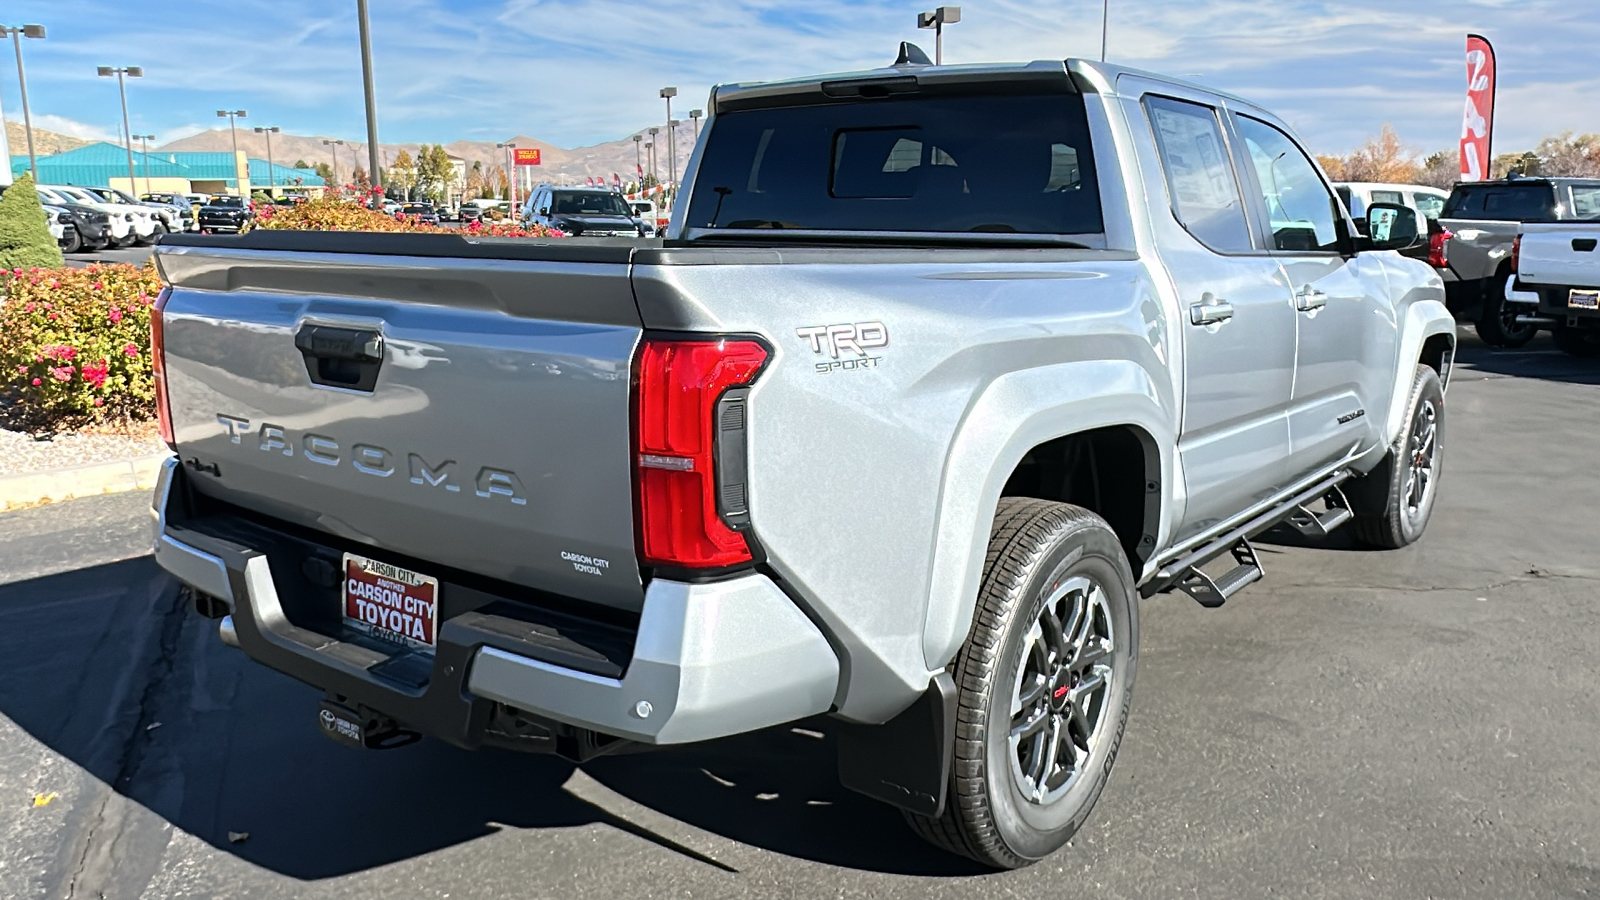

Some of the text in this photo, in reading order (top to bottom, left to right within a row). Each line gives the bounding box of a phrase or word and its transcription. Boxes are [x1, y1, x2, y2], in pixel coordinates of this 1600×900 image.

[795, 321, 889, 359] TRD
[815, 357, 883, 372] SPORT
[216, 413, 526, 505] TACOMA
[560, 551, 609, 568] CARSON CITY
[573, 562, 602, 576] TOYOTA
[366, 560, 416, 584] CARSON CITY
[377, 578, 406, 593] ANOTHER
[348, 579, 434, 619] CARSON CITY
[356, 599, 426, 641] TOYOTA
